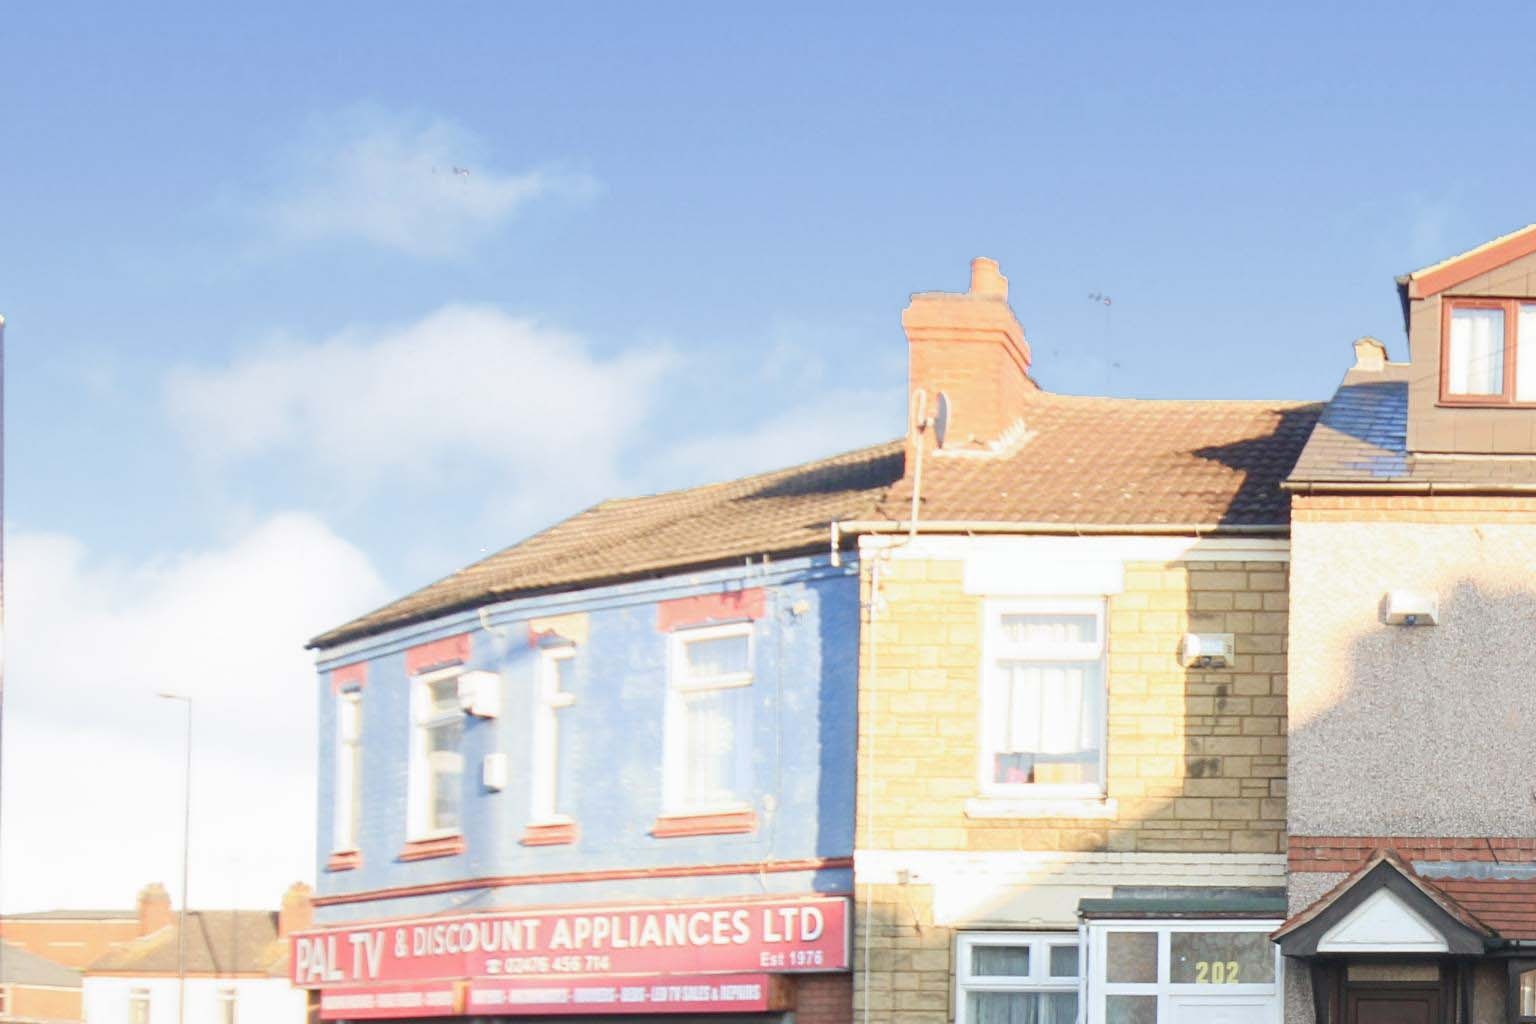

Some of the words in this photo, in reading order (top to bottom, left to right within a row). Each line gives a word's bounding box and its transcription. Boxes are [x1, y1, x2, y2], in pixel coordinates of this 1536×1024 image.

[296, 936, 344, 984] PAL
[348, 930, 385, 980] TV
[394, 928, 408, 958] &
[413, 918, 542, 957] DISCOUNT
[549, 909, 750, 950] APPLIANCES
[763, 907, 824, 942] LTD
[760, 951, 784, 967] Est
[1195, 961, 1240, 984] 202
